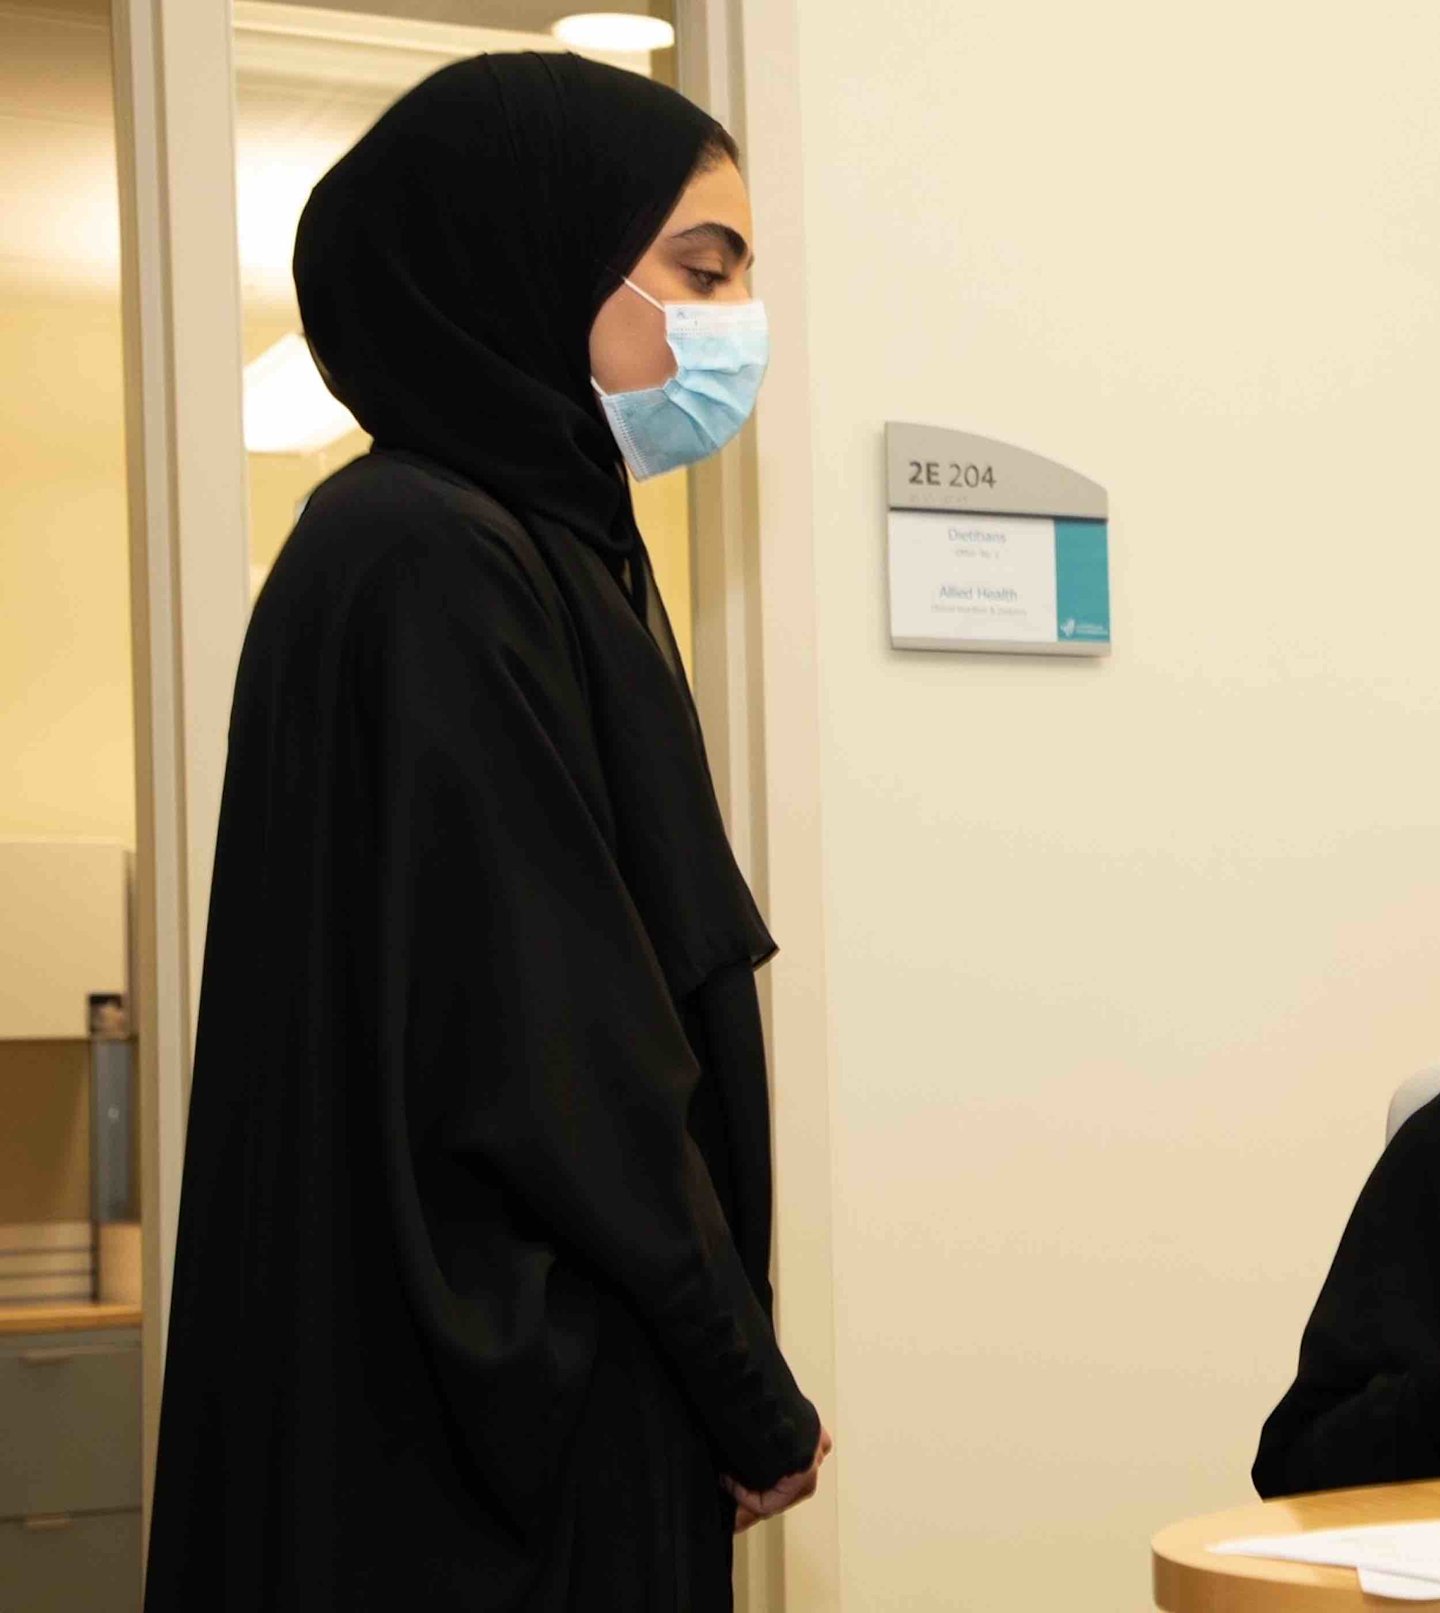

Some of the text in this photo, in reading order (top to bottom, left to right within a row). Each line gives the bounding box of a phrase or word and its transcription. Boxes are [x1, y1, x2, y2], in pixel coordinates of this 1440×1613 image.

[909, 461, 997, 489] 2E 204
[977, 586, 1018, 603] Health
